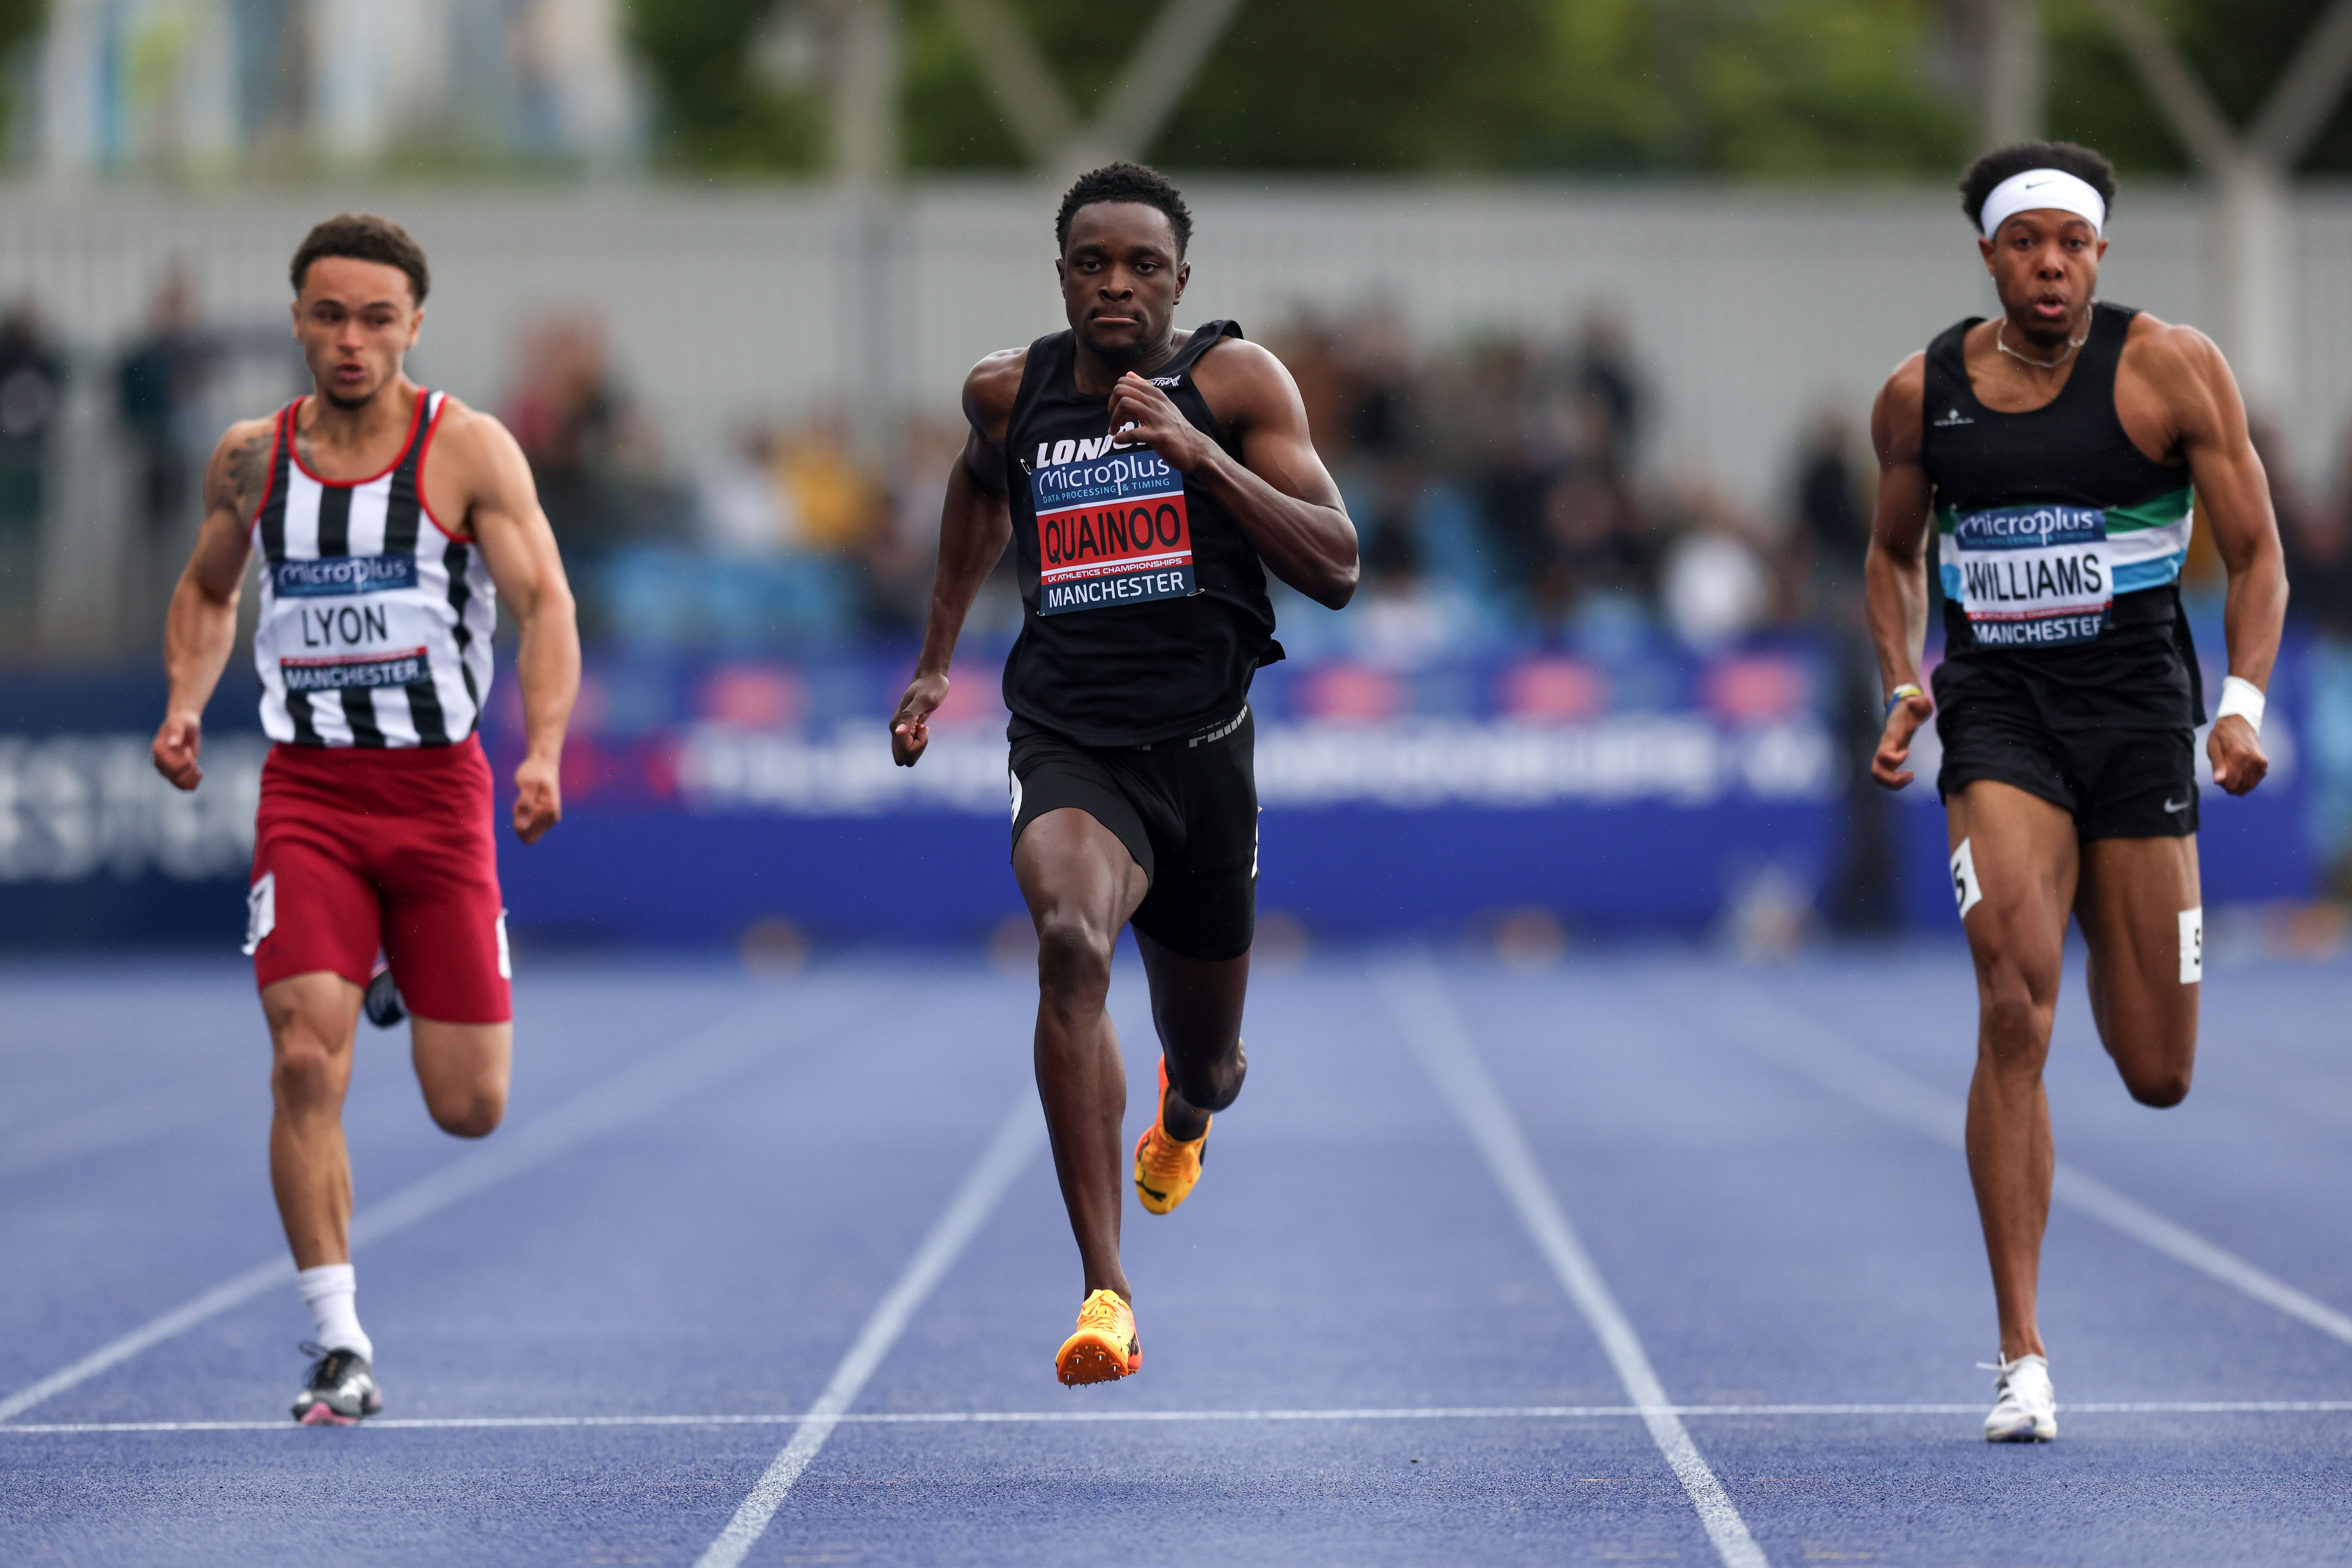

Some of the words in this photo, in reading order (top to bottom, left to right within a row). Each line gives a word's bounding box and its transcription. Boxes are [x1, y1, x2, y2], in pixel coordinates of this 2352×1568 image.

[1036, 420, 1146, 469] LONDO
[1043, 494, 1060, 503] DATA
[1062, 485, 1116, 500] PROCESSING
[1132, 478, 1170, 490] TIMING
[1046, 503, 1180, 565] QUAINOO
[1049, 571, 1185, 608] MANCHESTER
[1057, 569, 1101, 581] ATHLETICS
[1102, 557, 1183, 575] CHAMPIONSHIPS
[1965, 554, 2102, 601] WILLIAMS
[302, 605, 387, 647] LYON
